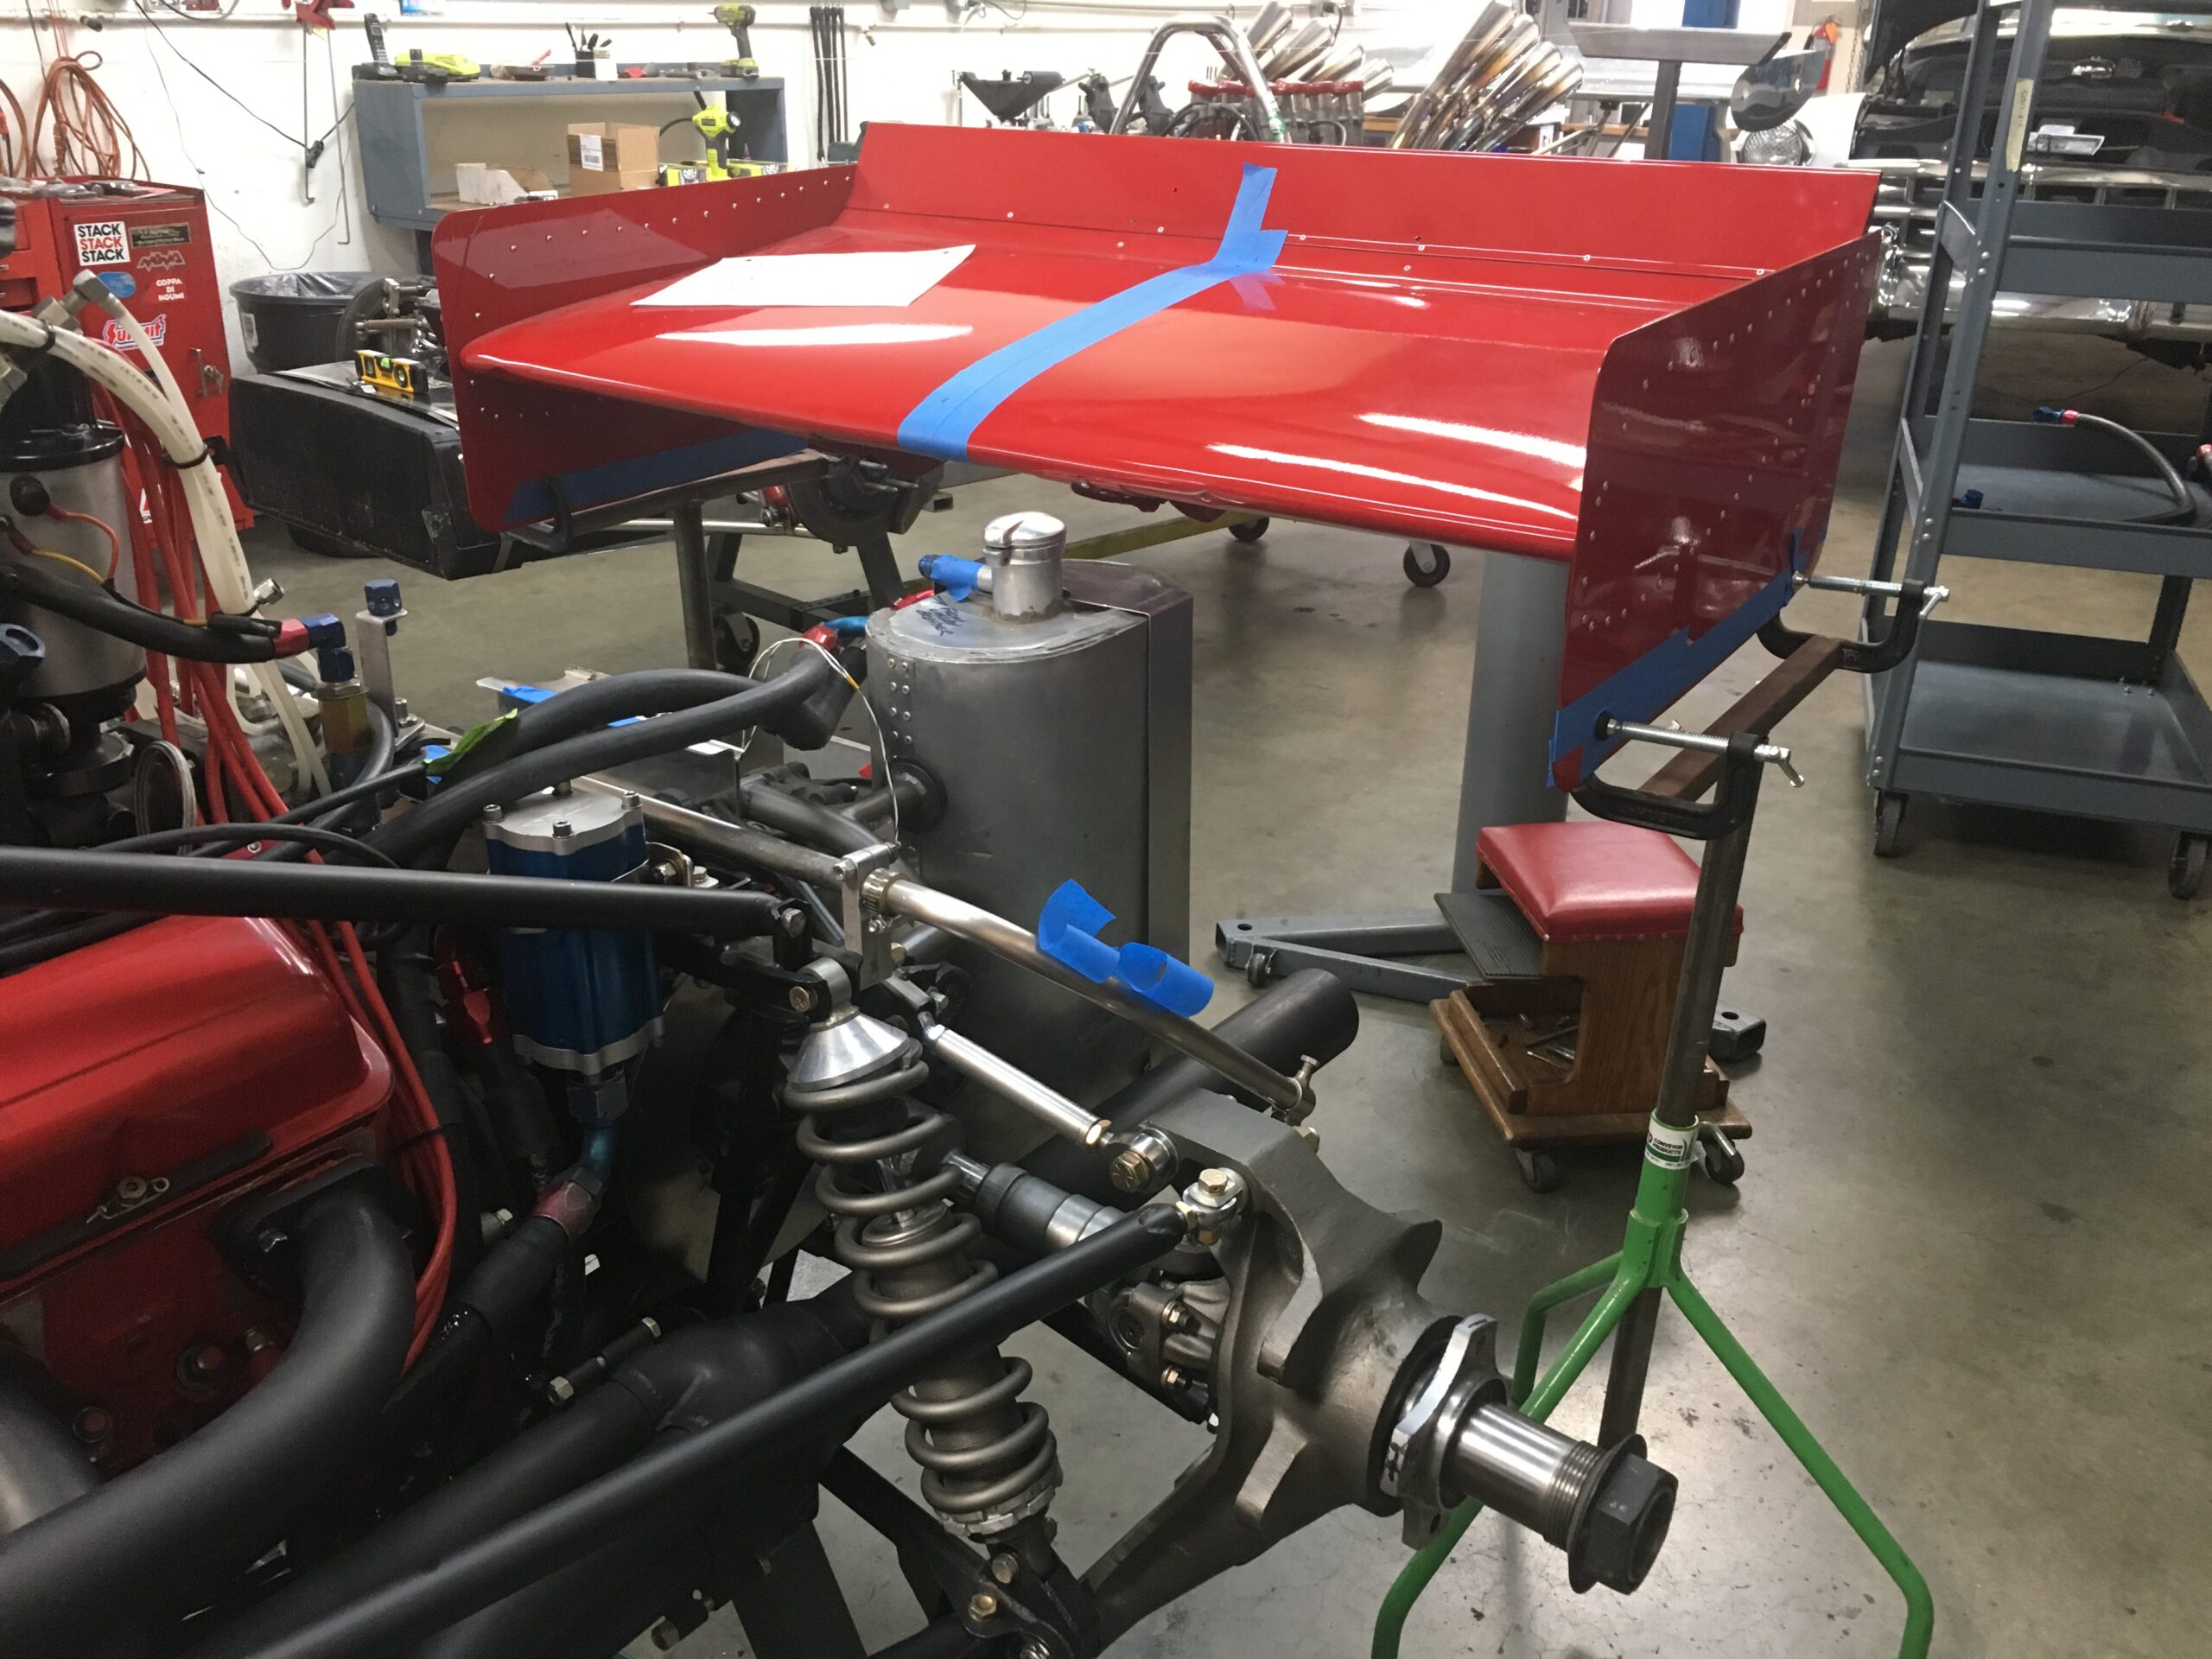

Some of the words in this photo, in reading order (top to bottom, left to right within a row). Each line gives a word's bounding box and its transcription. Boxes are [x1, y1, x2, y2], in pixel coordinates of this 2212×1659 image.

[78, 223, 121, 238] STACK
[79, 236, 123, 251] STACK
[81, 249, 125, 263] STACK
[156, 277, 183, 287] COPPA
[1652, 1142, 1681, 1155] PRODUCTS
